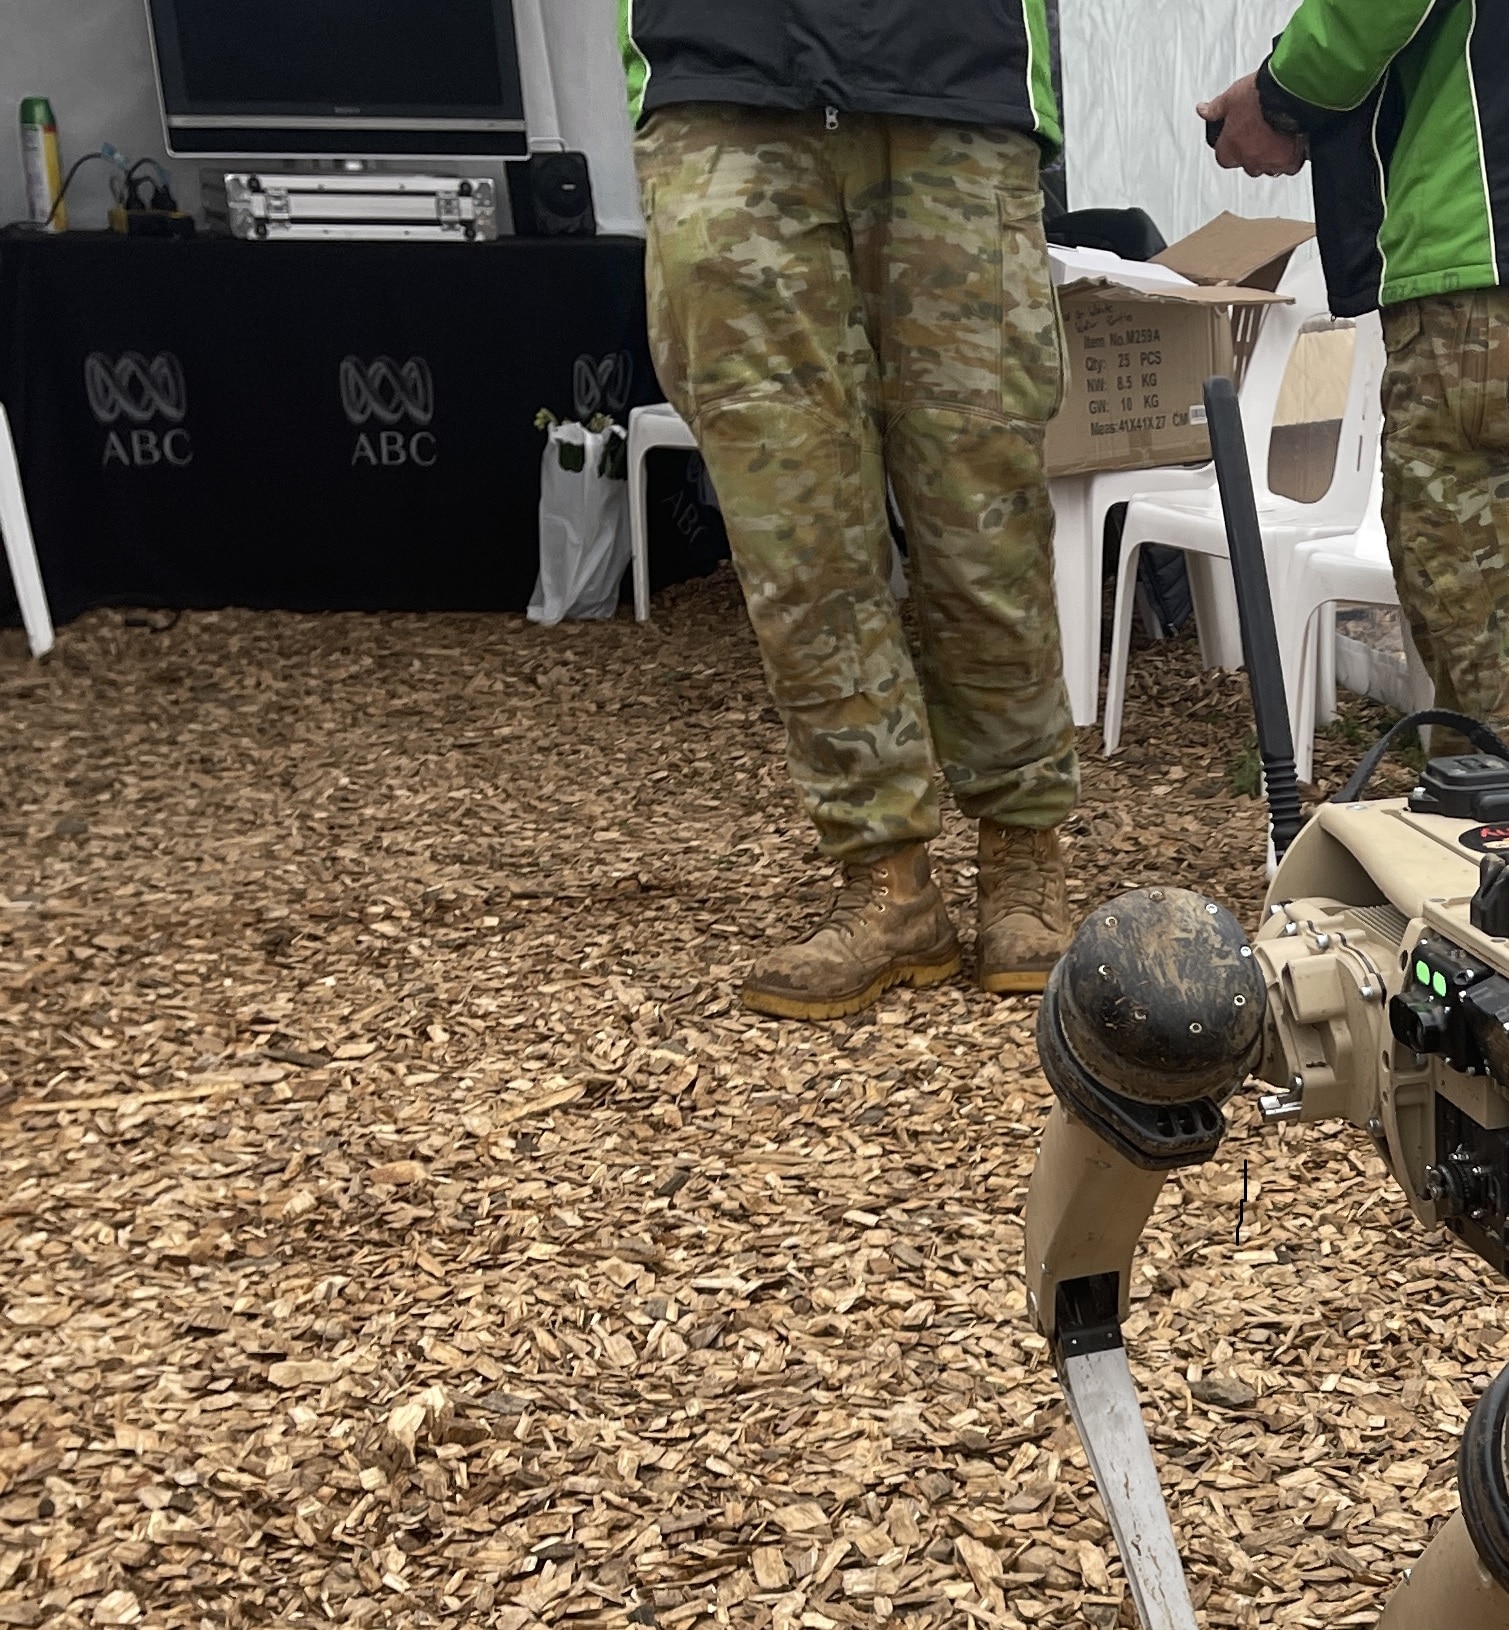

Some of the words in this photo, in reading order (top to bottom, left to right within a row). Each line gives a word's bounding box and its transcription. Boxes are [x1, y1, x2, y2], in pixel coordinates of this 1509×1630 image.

[1084, 334, 1105, 349] Item
[1118, 352, 1131, 368] 25
[1140, 350, 1162, 366] PCS
[1117, 375, 1133, 391] 8.5
[1141, 373, 1158, 388] KG
[1121, 397, 1133, 412] 10
[1143, 394, 1160, 409] KG
[1172, 411, 1190, 427] CM
[102, 428, 194, 466] ABC
[351, 431, 438, 467] ABC
